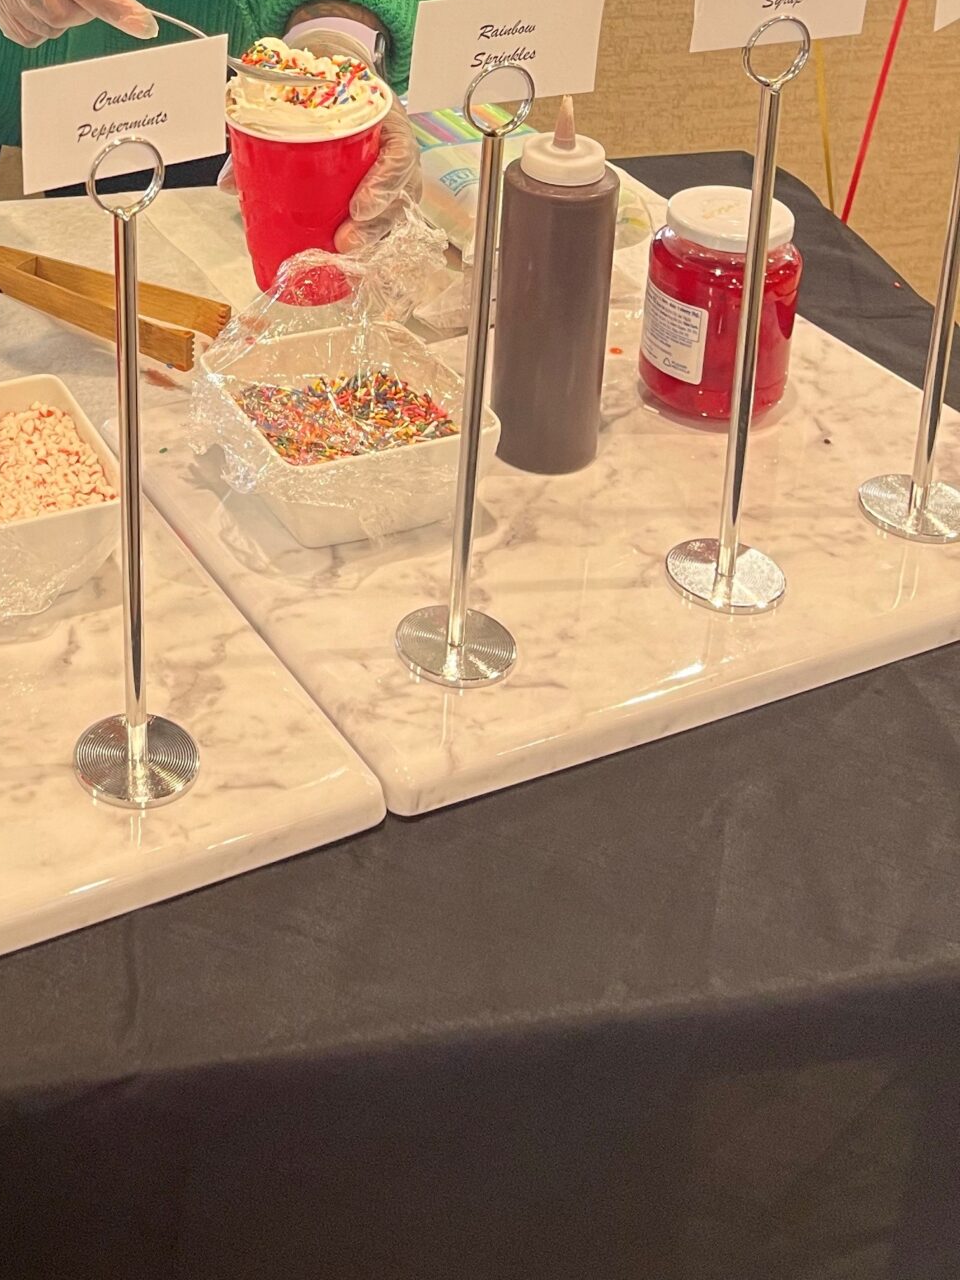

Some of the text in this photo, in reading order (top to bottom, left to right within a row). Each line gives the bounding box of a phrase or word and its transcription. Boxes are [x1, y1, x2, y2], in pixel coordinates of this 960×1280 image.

[477, 21, 537, 41] Rainbow
[470, 46, 537, 68] Sprinkles
[93, 83, 155, 112] Crushed
[77, 111, 168, 142] Peppermints
